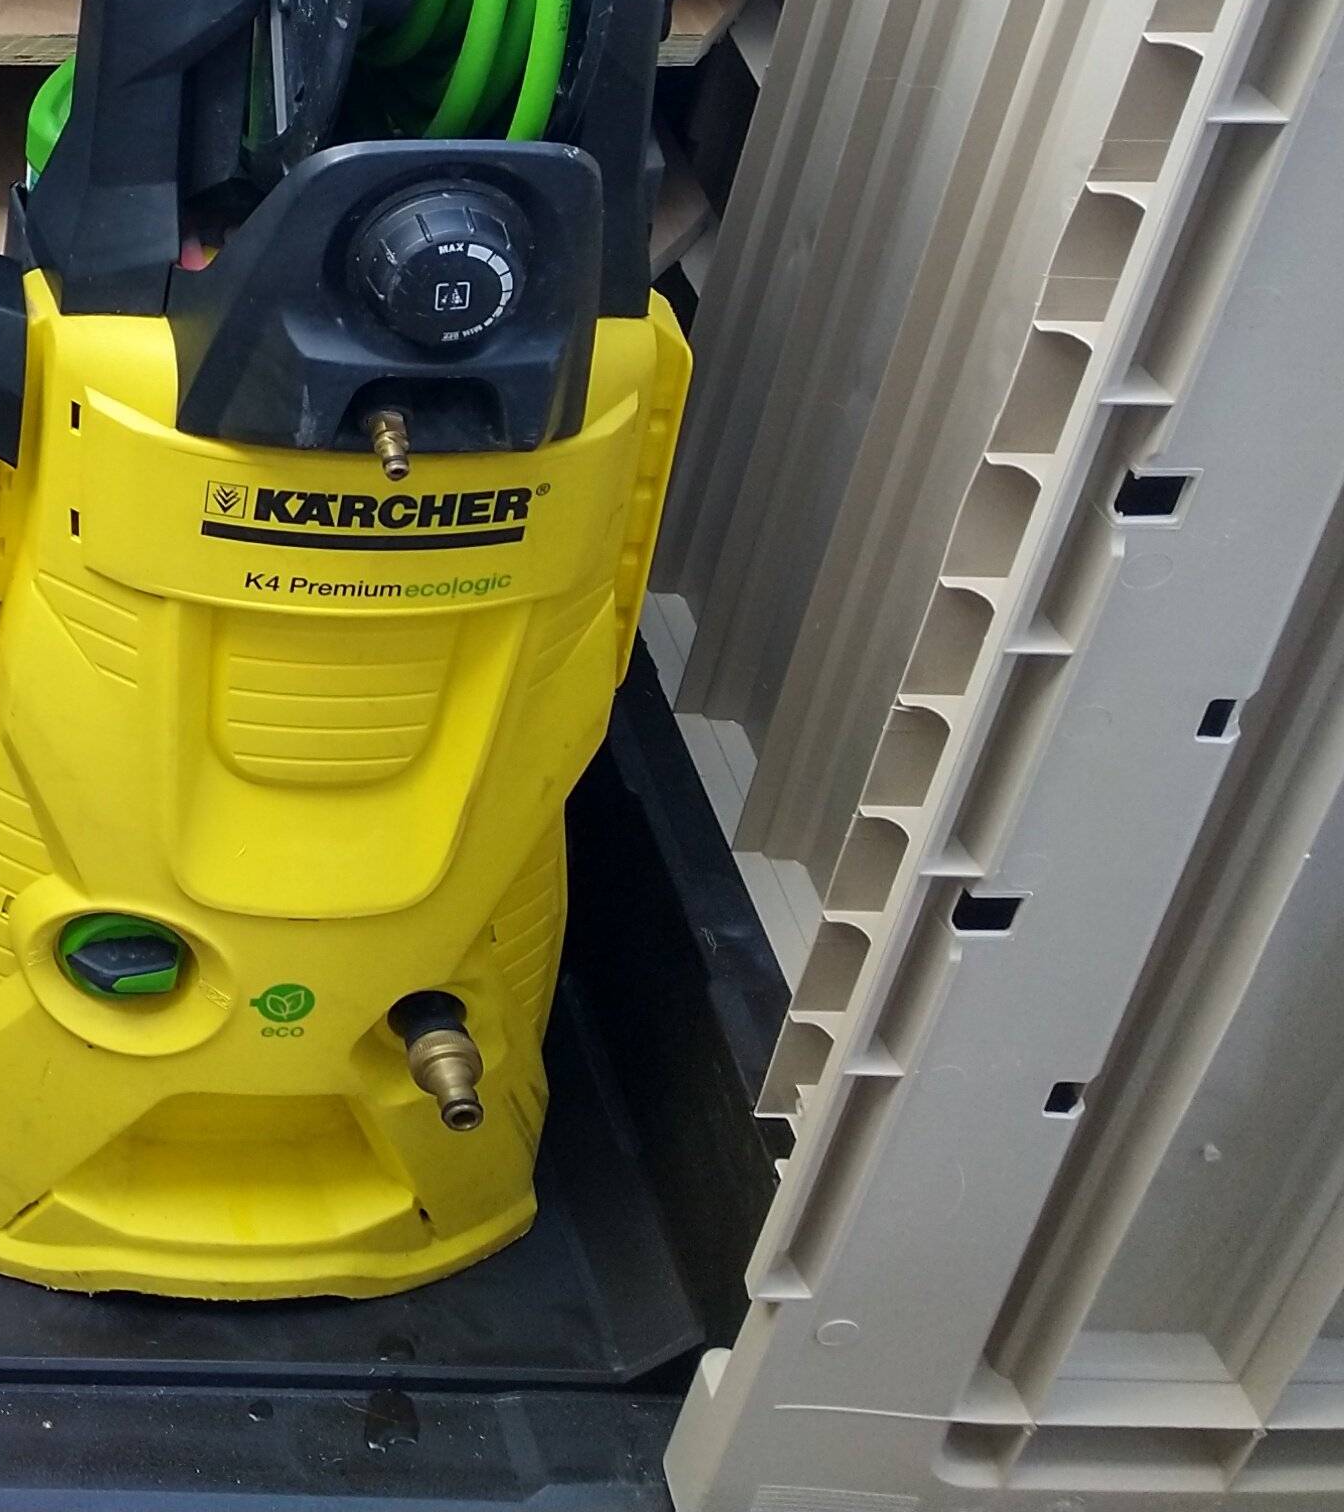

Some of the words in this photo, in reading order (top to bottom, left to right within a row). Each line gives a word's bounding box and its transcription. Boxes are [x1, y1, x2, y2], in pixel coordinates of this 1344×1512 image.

[438, 242, 465, 255] MAX
[254, 487, 533, 529] KÄRCHER
[245, 572, 280, 593] K4
[260, 1024, 305, 1039] eco
